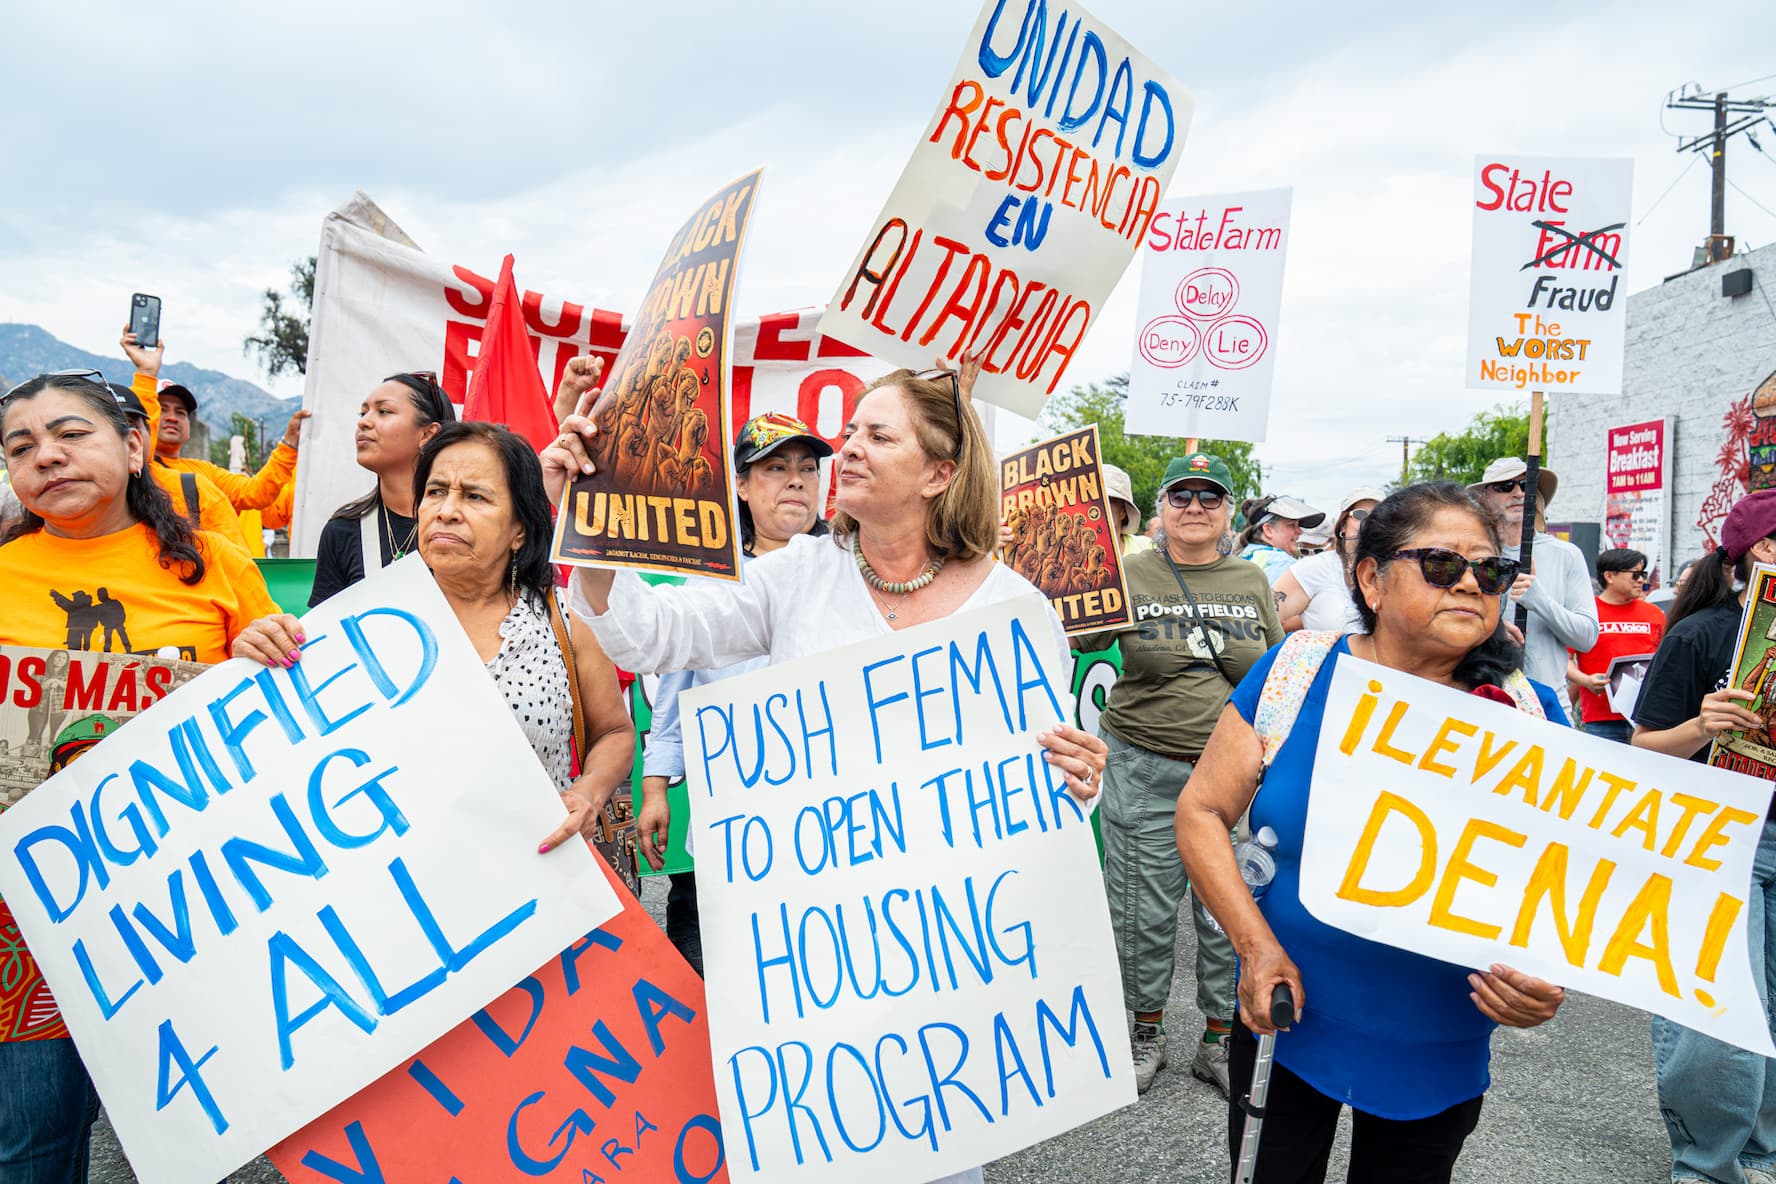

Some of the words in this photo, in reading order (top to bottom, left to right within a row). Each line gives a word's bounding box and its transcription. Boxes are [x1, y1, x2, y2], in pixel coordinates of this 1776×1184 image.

[978, 0, 1174, 167] UNIDAD
[929, 80, 1161, 250] RESISTENCIA
[1476, 163, 1573, 213] State
[985, 194, 1053, 251] EN
[841, 217, 1090, 395] ALTADENA
[1187, 284, 1231, 308] Delay
[1527, 275, 1618, 312] Fraud
[1150, 334, 1190, 356] Deny
[1218, 331, 1249, 353] Lie
[1497, 337, 1591, 361] WORST
[1514, 313, 1561, 336] The
[1480, 359, 1581, 389] Neighbor
[1004, 434, 1094, 490] BLACK
[1610, 444, 1659, 473] Breakfast
[1613, 433, 1628, 448] Now
[1629, 428, 1657, 445] Serving
[1003, 471, 1100, 520] BROWN
[1041, 475, 1050, 487] &
[1612, 475, 1626, 488] 7AM
[1627, 475, 1634, 486] to
[1636, 472, 1655, 485] 11AM
[575, 491, 727, 549] UNITED
[1049, 587, 1122, 622] ITED
[1197, 604, 1257, 618] FIELDS
[1200, 593, 1213, 601] TO
[1605, 623, 1620, 633] LA
[1621, 623, 1649, 633] Voice
[64, 659, 172, 711] MÁS
[697, 680, 837, 797] PUSH
[863, 618, 1065, 764] FEMA
[14, 607, 438, 924] DIGNIFIED
[709, 814, 773, 884] TO
[795, 782, 906, 876] OPEN
[921, 747, 1085, 849] THEIR
[73, 748, 410, 1021] LIVING
[1336, 790, 1744, 1010] DENA!
[752, 870, 1037, 1025] HOUSING
[156, 1018, 229, 1136] 4
[268, 856, 538, 1071] ALL
[727, 984, 1111, 1172] PROGRAM
